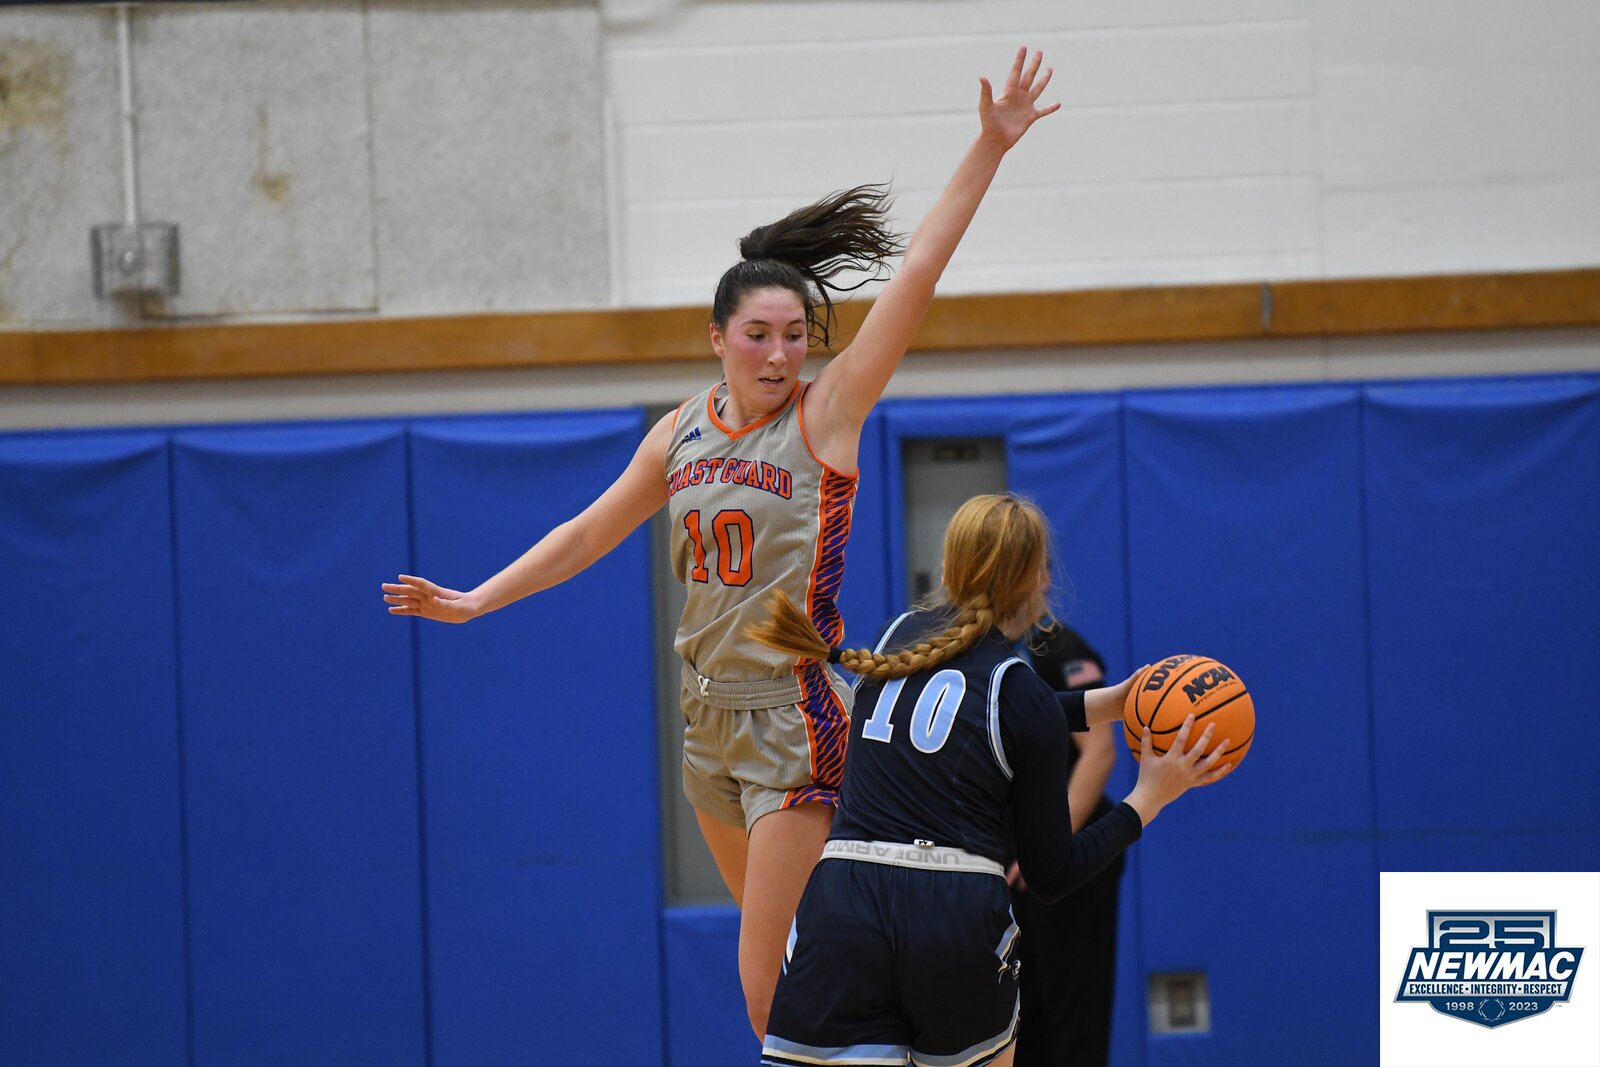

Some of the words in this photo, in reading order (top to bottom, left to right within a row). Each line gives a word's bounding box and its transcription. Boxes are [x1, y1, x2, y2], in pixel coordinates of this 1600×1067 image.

[669, 457, 725, 497] OAST
[720, 457, 792, 500] GUARD
[683, 509, 754, 587] 10
[862, 669, 966, 754] 10
[1182, 666, 1235, 704] NCAA
